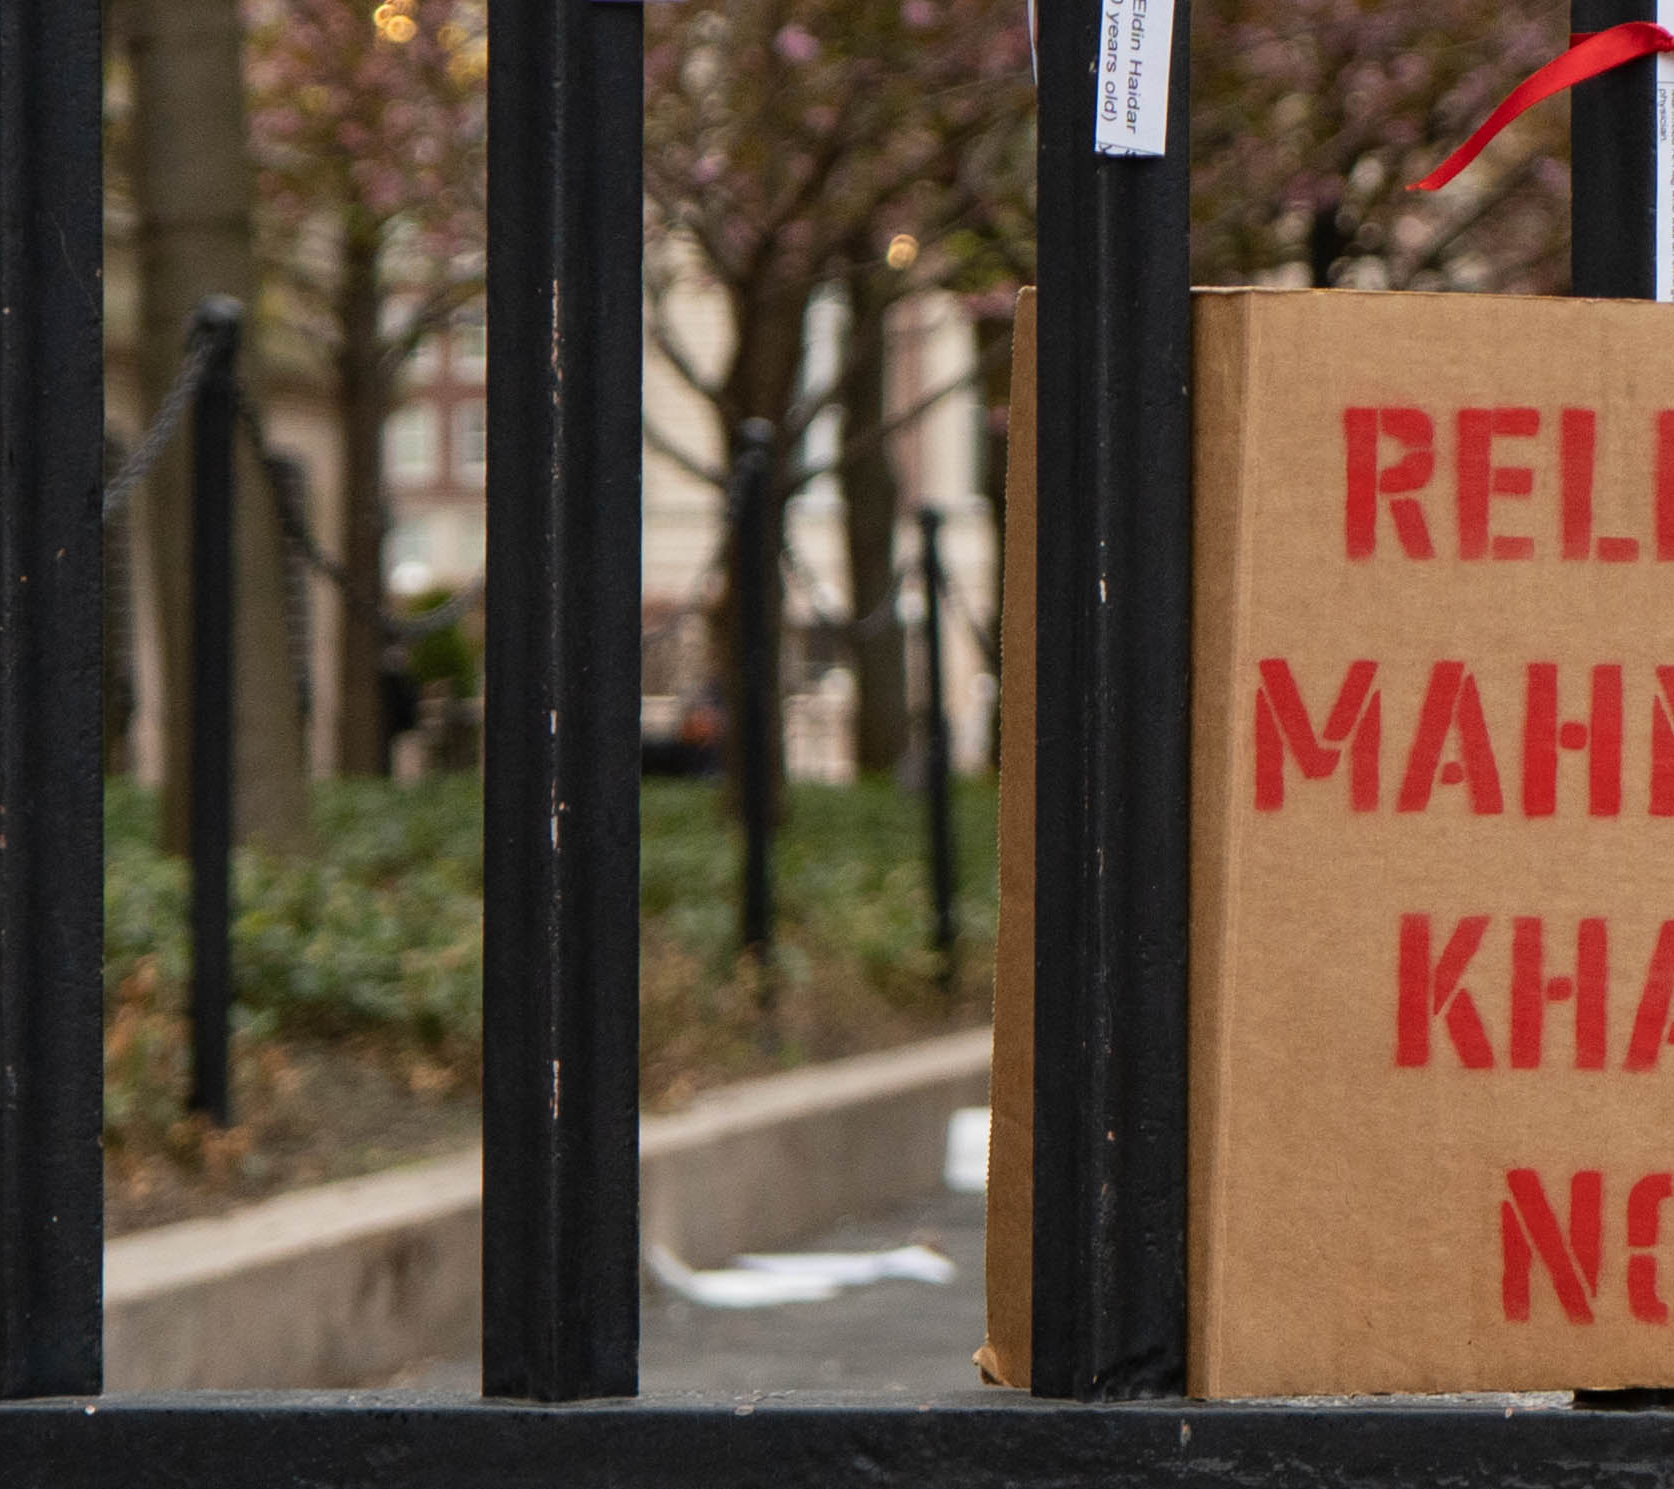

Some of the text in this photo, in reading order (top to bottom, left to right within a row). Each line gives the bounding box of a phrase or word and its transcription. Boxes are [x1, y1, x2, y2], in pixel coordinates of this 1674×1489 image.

[1105, 11, 1123, 73] years
[1101, 81, 1119, 122] old)
[1125, 59, 1144, 134] Haidar
